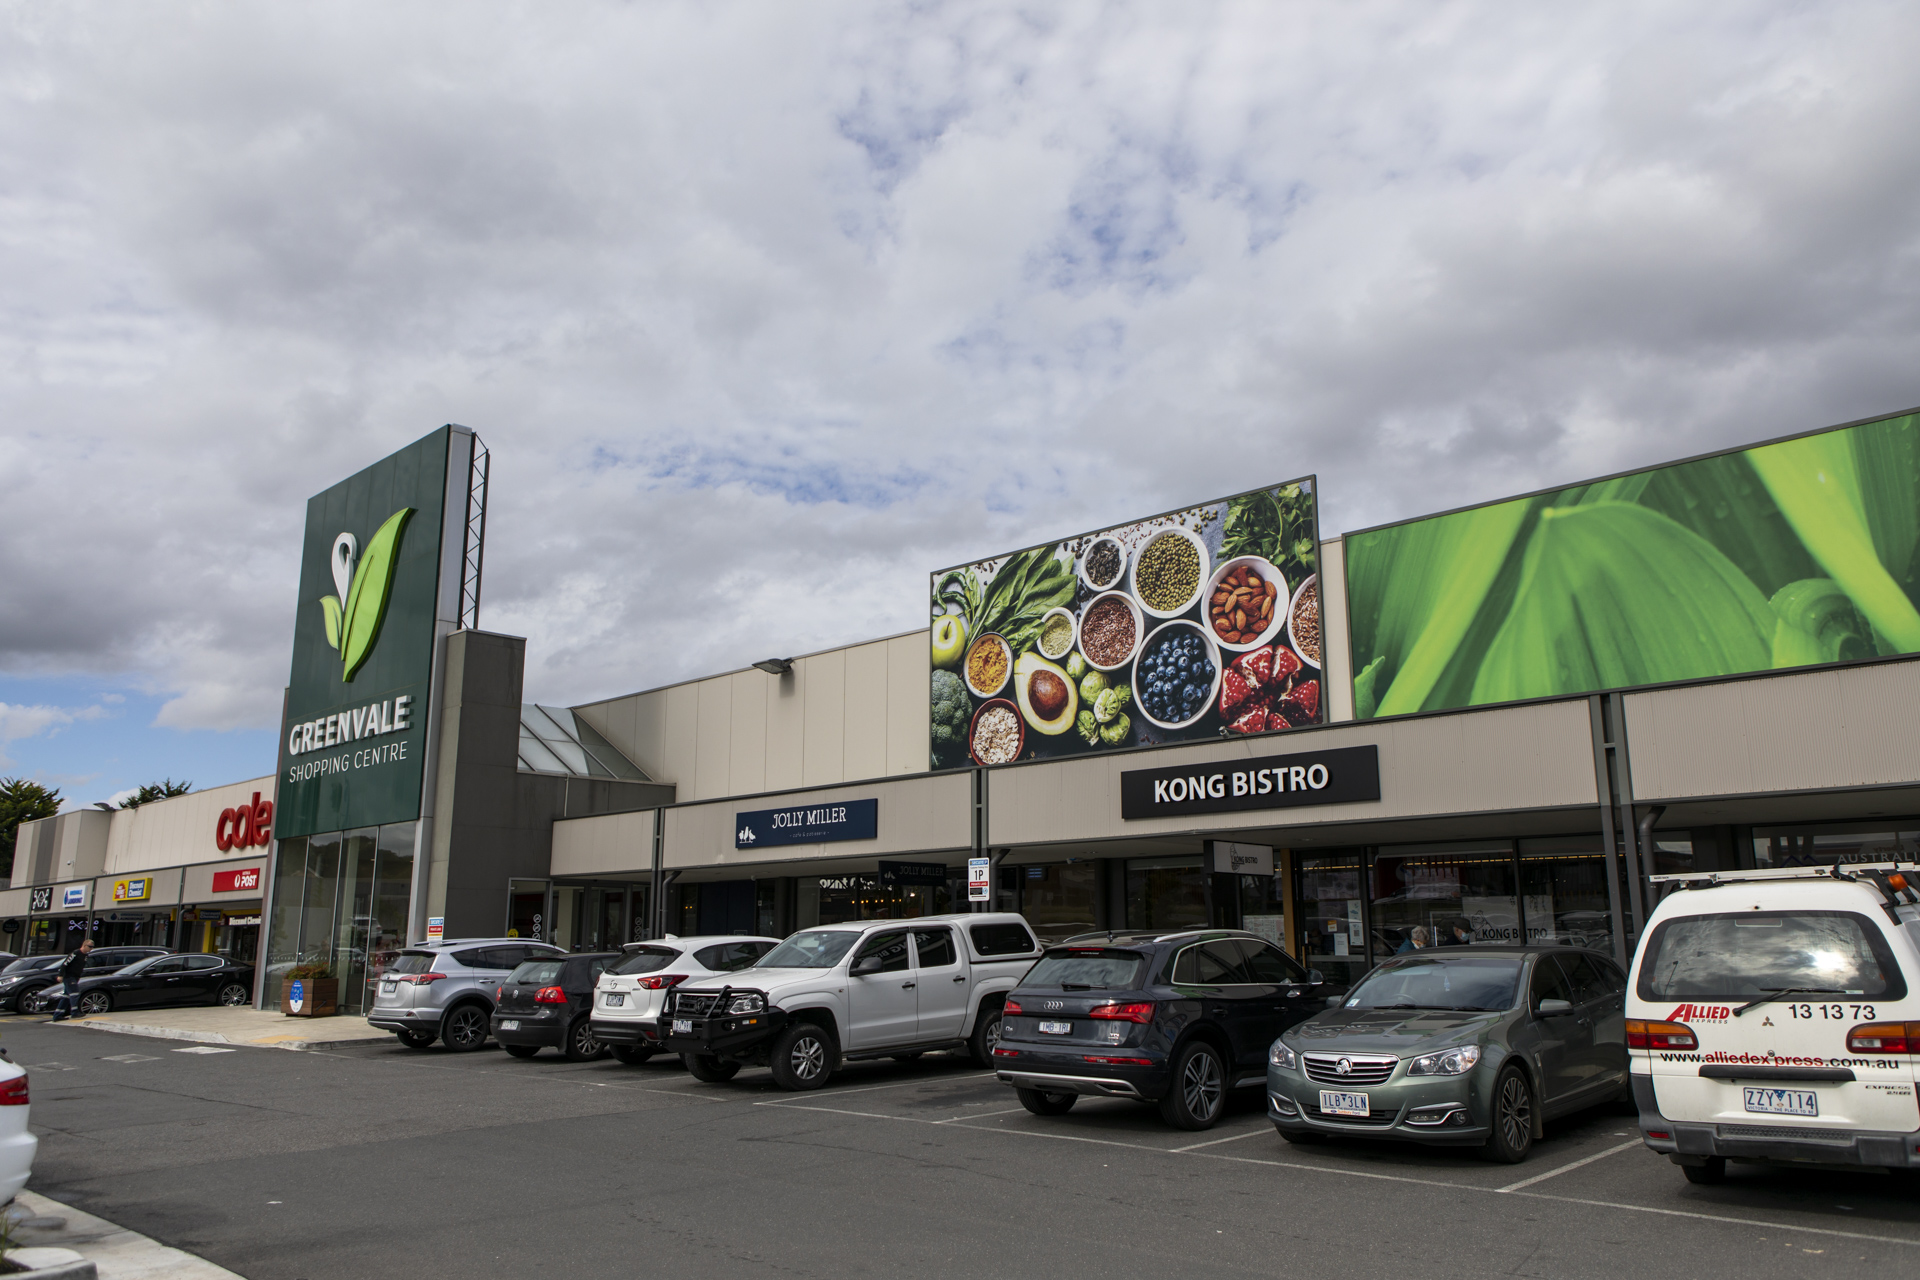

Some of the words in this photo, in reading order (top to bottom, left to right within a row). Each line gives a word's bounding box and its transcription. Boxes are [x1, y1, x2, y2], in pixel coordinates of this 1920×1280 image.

[289, 695, 412, 755] GREENVALE
[289, 754, 350, 783] SHOPPING
[354, 741, 408, 769] CENTRE
[1154, 773, 1226, 803] KONG
[1231, 763, 1330, 796] BISTRO
[216, 791, 273, 851] cole
[772, 811, 804, 829] JOLLY
[806, 807, 847, 825] MILLER
[1837, 851, 1918, 864] AUSTRALI
[899, 866, 920, 876] JOLLY
[920, 867, 944, 877] MILLER
[974, 870, 983, 880] 1P
[240, 875, 257, 887] POST
[1482, 928, 1510, 939] KONG
[1665, 1004, 1730, 1022] ALLIED
[1788, 1004, 1813, 1019] 13
[1819, 1004, 1844, 1019] 13
[1850, 1005, 1876, 1020] 73
[1323, 1094, 1341, 1107] 1LB
[1347, 1095, 1367, 1108] 3LN
[1747, 1090, 1774, 1107] ZZY
[1787, 1093, 1815, 1110] 114
